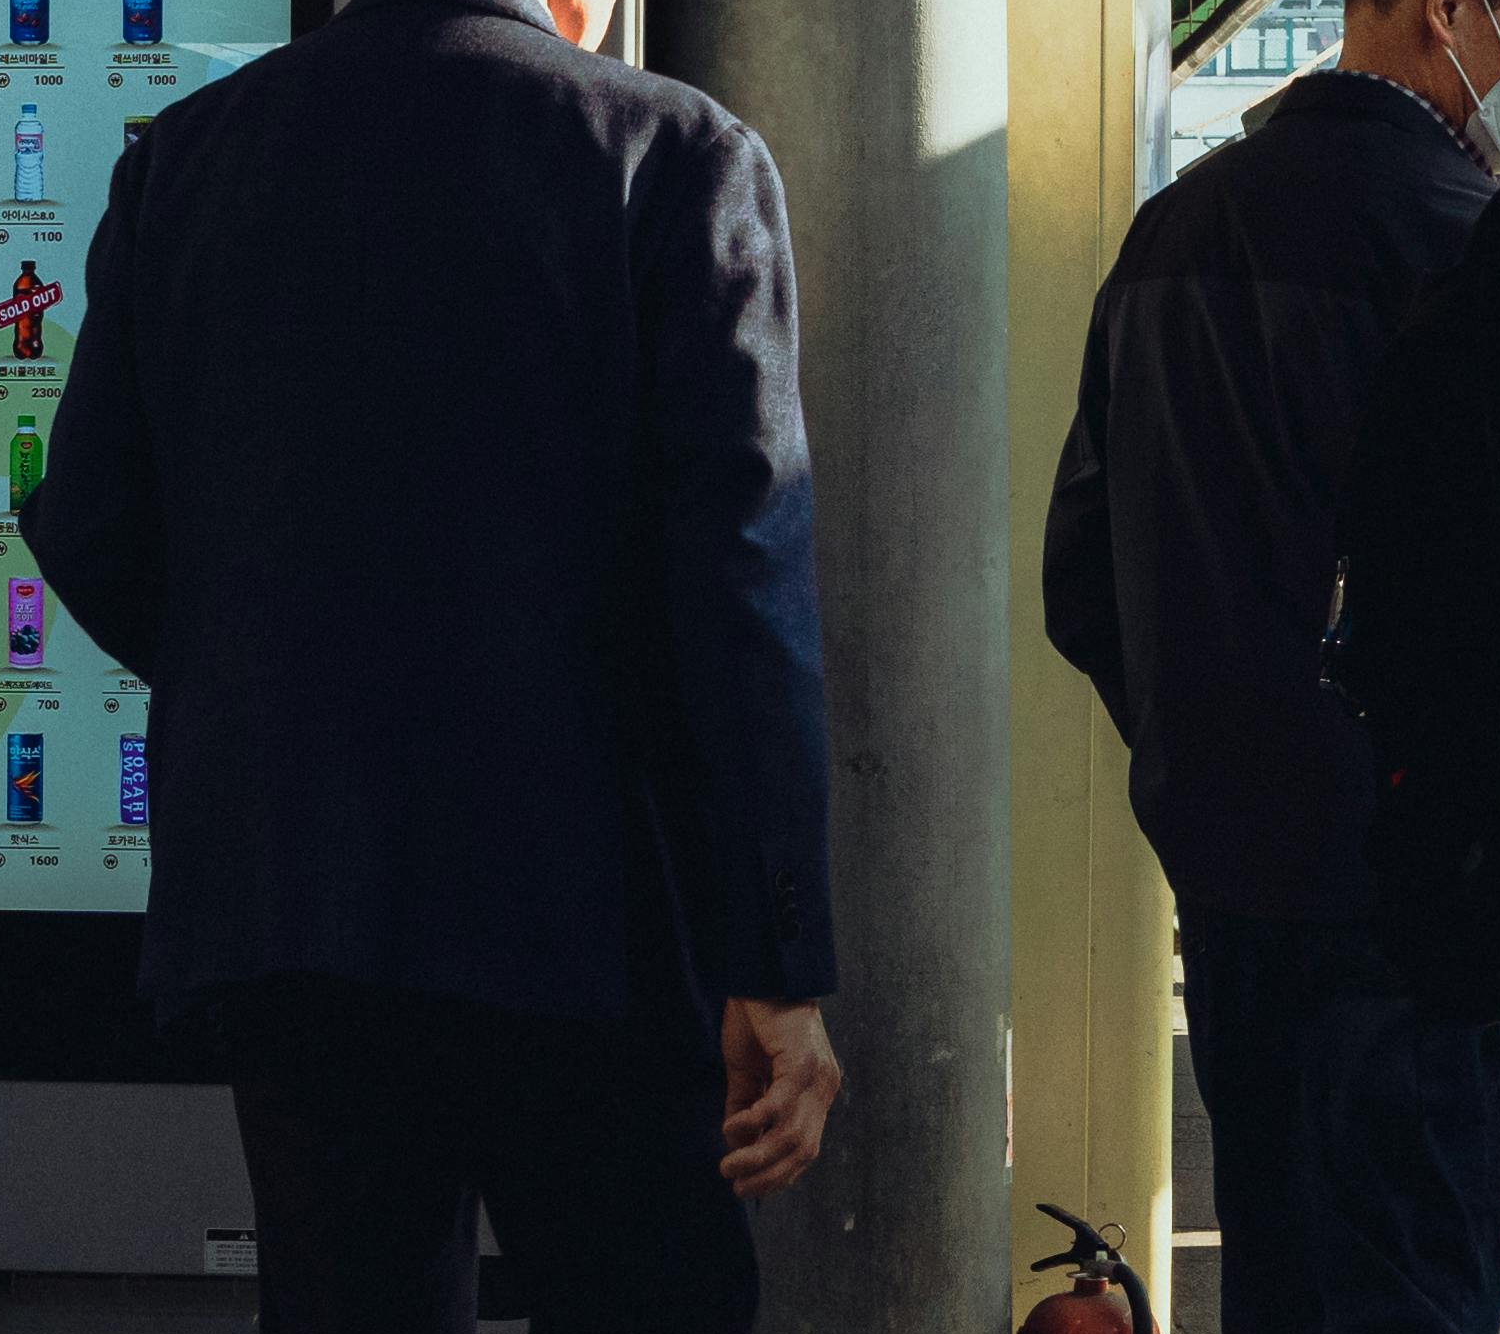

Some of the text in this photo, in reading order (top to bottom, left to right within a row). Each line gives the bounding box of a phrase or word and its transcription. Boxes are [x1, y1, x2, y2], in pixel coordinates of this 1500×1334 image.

[0, 53, 58, 65] 레쓰비마일드
[112, 53, 171, 65] 레쓰비마일드
[34, 75, 63, 86] 1000
[147, 75, 176, 86] 1000
[1, 210, 55, 221] 아이시스8.0
[33, 231, 62, 242] 1100
[0, 287, 57, 322] SOLD OUT
[31, 387, 61, 398] 2300
[37, 699, 60, 710] 700
[11, 834, 39, 845] 핫식스
[30, 856, 58, 866] 1600
